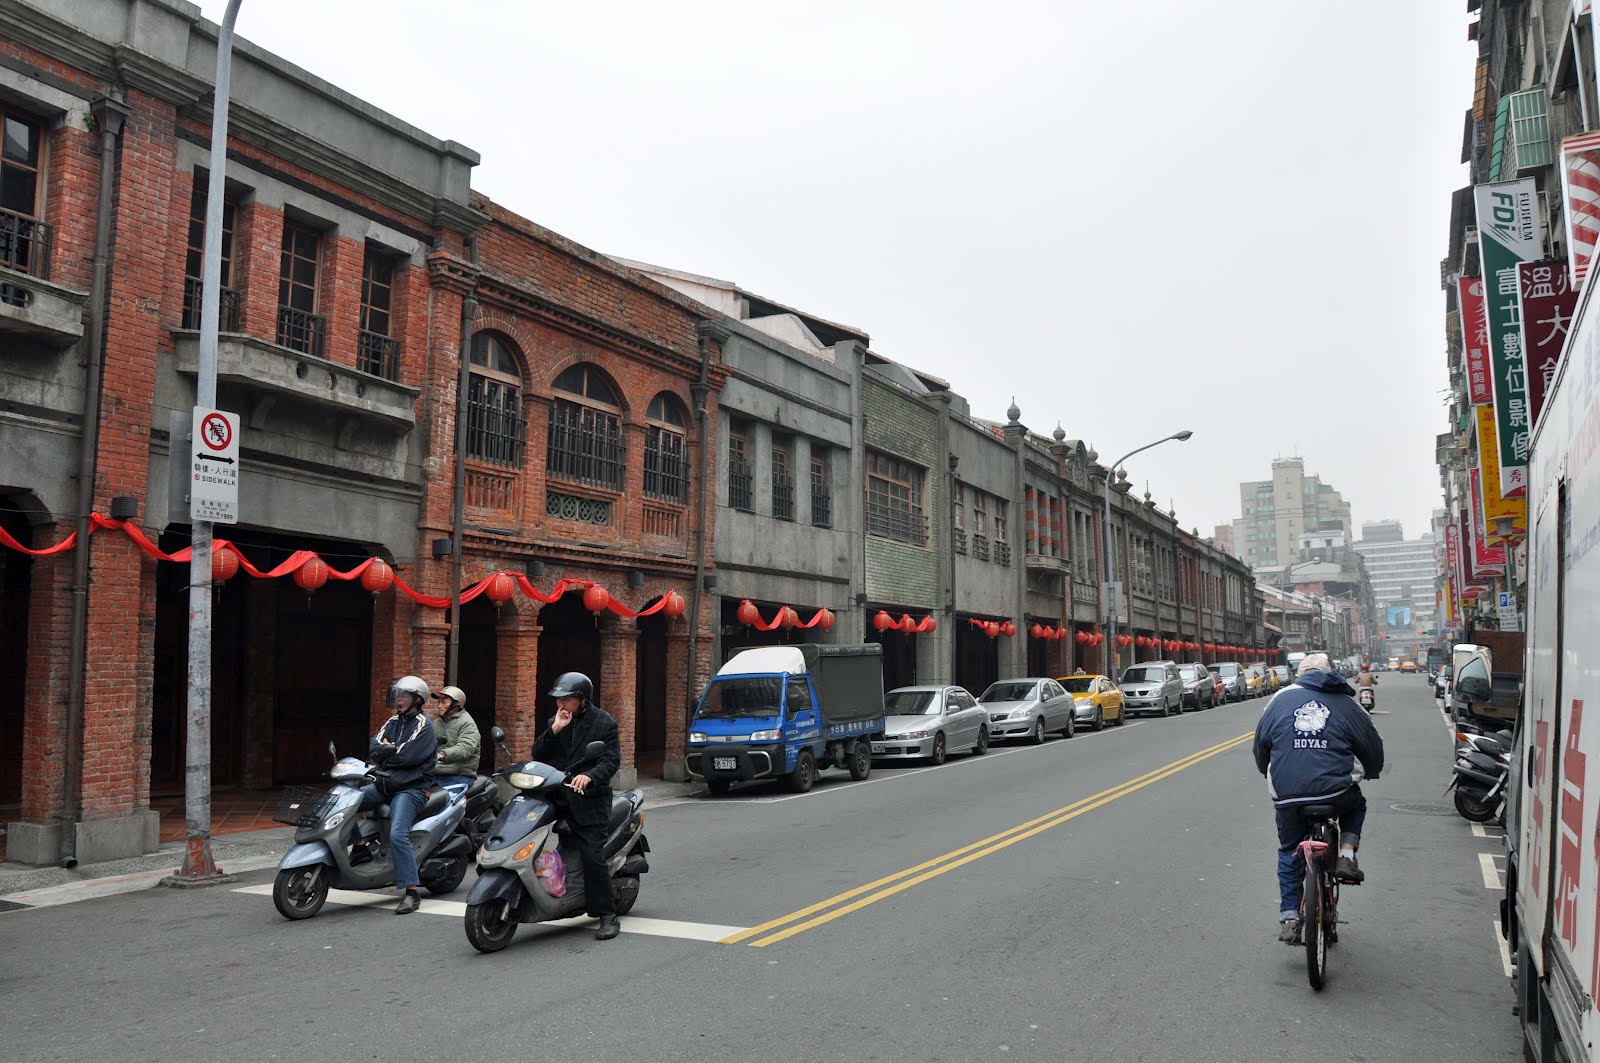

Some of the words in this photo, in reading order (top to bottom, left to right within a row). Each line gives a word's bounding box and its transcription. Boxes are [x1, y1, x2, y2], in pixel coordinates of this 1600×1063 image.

[1519, 192, 1533, 241] FUJIFILM
[1495, 266, 1528, 462] 富士數位影像
[202, 475, 236, 486] SIDEWALK
[1500, 596, 1507, 606] P
[1293, 739, 1328, 749] HOYAS
